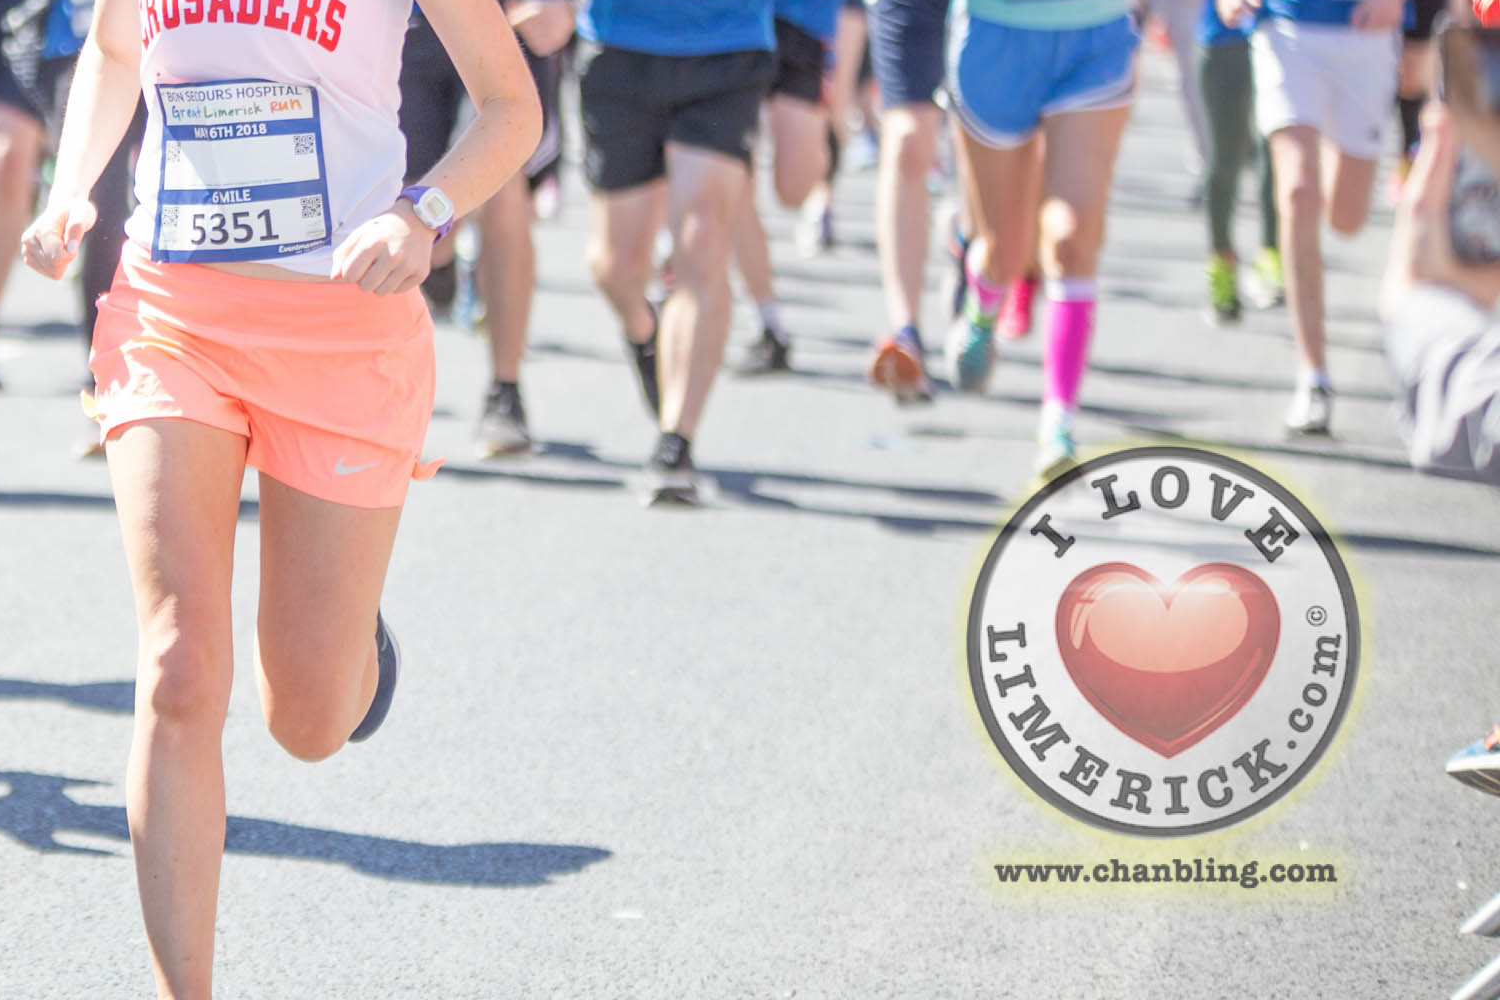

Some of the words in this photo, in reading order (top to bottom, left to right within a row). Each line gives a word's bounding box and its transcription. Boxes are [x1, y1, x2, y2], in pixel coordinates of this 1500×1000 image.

[166, 90, 184, 103] BON
[186, 87, 233, 102] SECOURS
[236, 85, 303, 99] HOSPITAL
[171, 105, 202, 120] Great
[204, 102, 263, 119] Limerick
[209, 126, 234, 139] 6TH
[236, 123, 268, 137] 2018
[191, 208, 279, 246] 5351
